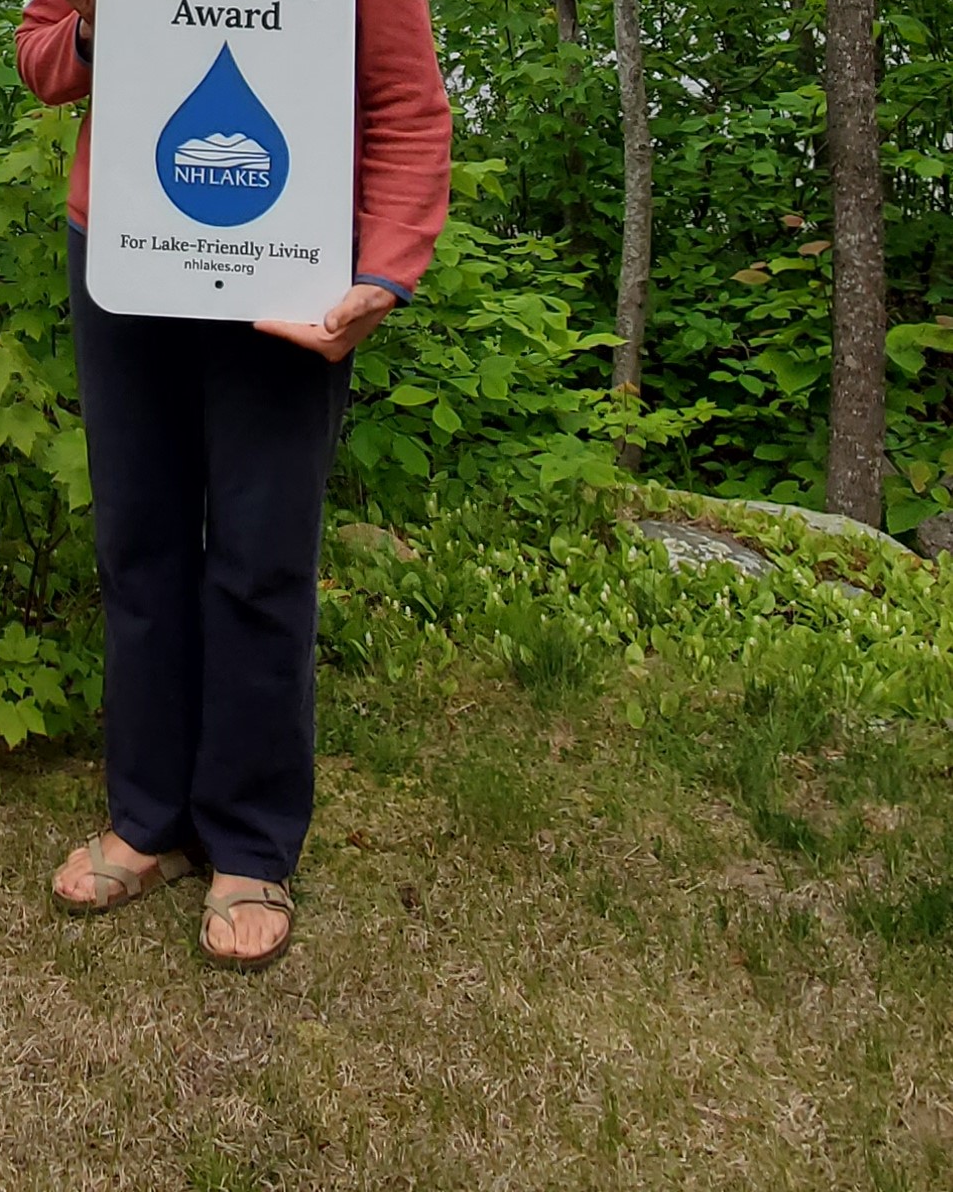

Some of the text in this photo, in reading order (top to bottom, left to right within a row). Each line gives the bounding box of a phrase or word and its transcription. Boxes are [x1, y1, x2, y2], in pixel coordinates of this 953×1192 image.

[120, 234, 321, 265] For Lake-Friendly Living
[184, 259, 255, 275] nhlakes.org
